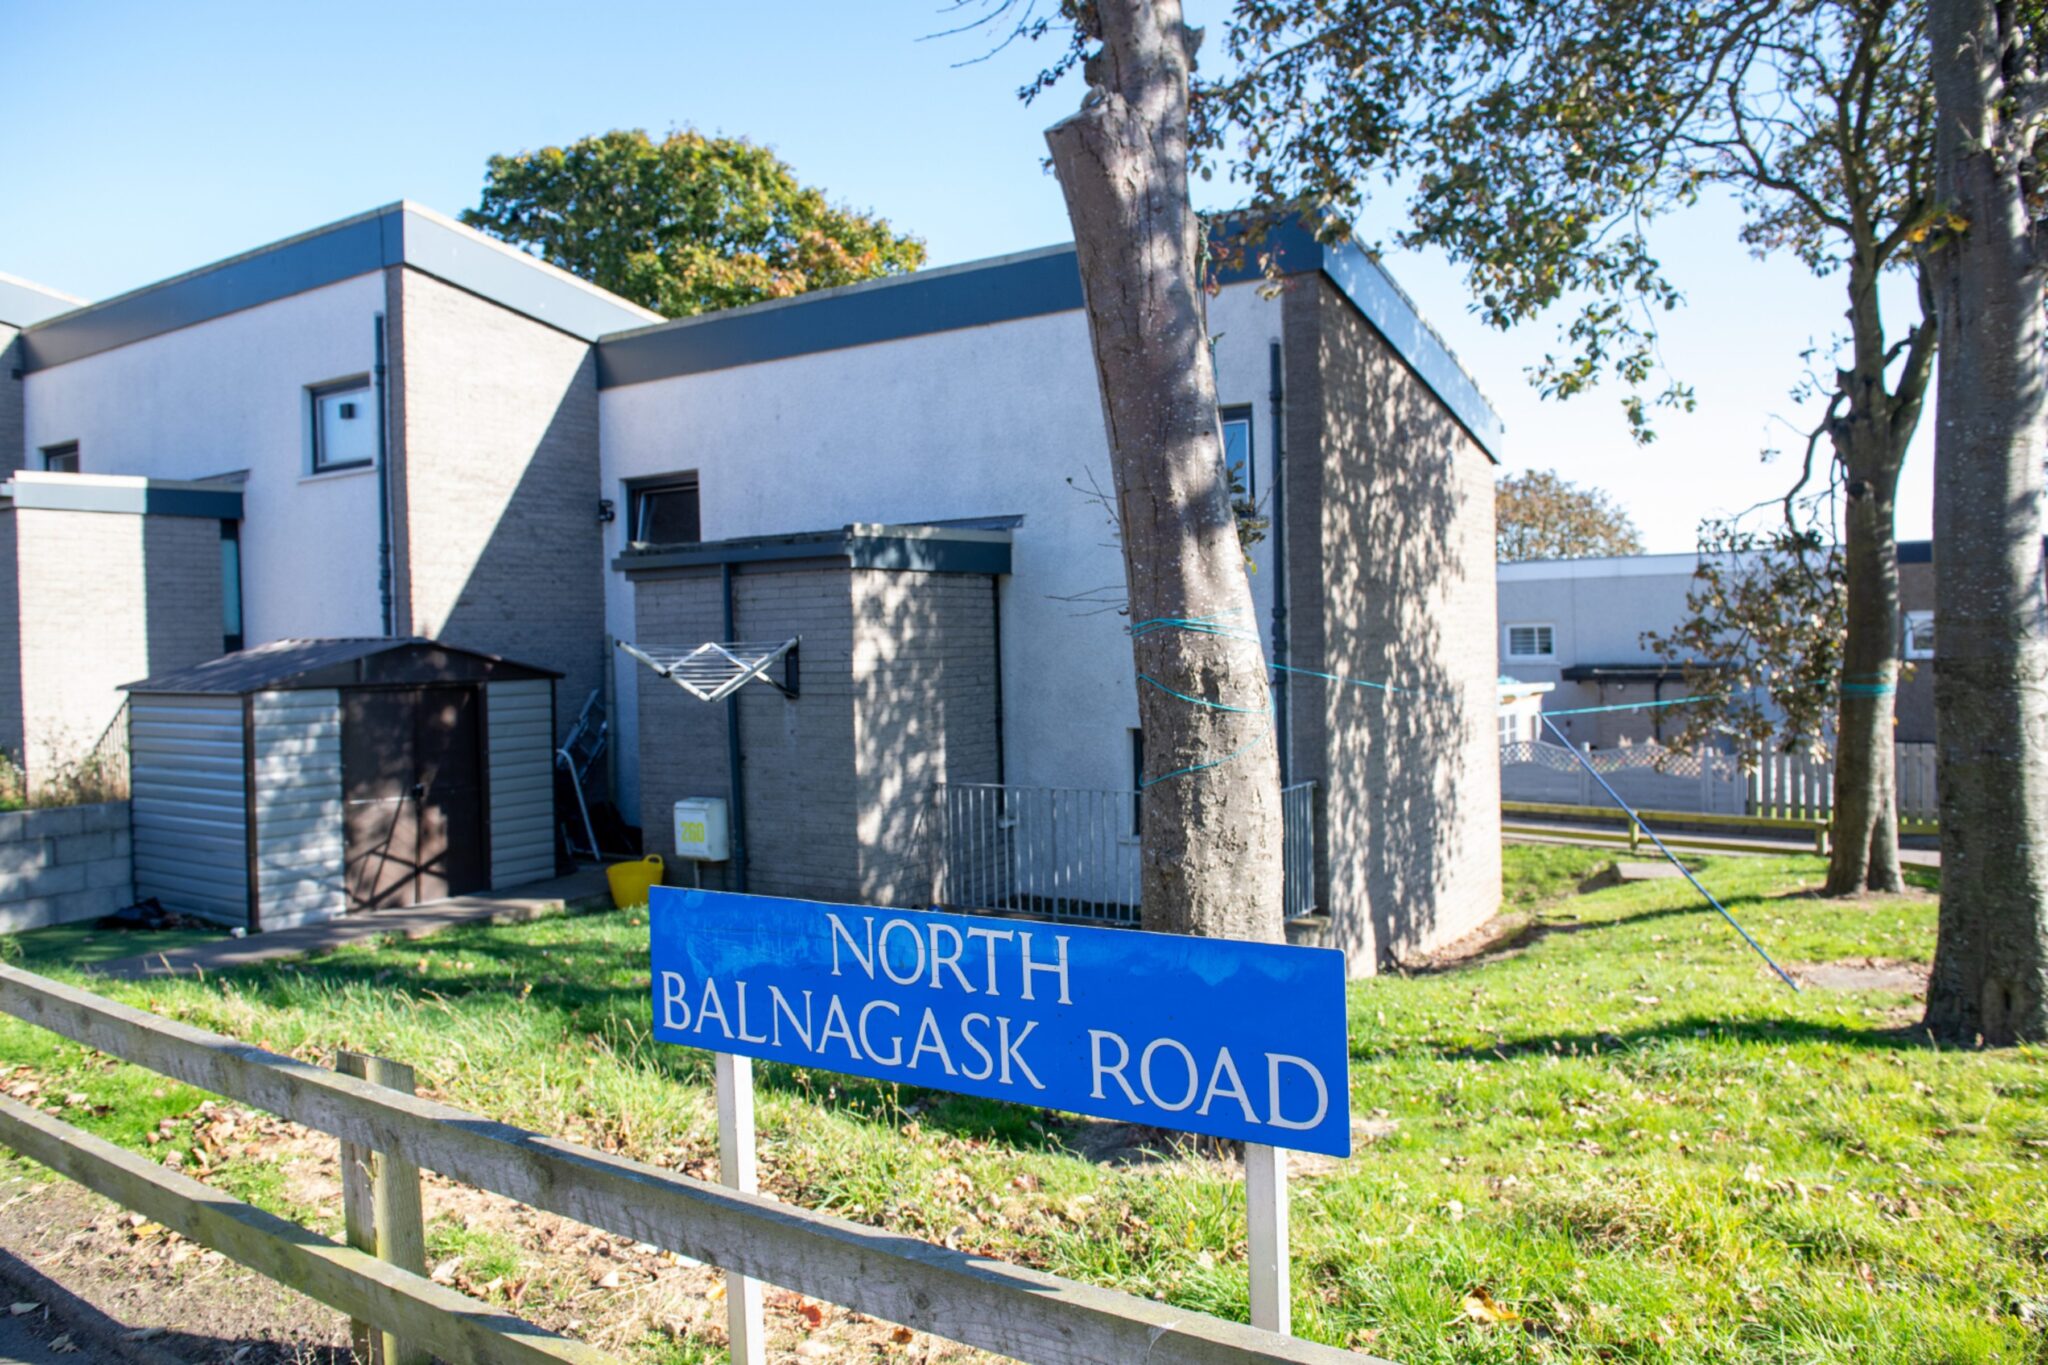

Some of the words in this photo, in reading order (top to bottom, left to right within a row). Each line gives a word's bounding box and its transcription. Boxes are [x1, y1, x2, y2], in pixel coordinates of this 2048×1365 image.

[828, 913, 1073, 1005] NORTH
[660, 971, 1046, 1090] BALNAGASK
[1088, 1029, 1329, 1131] ROAD
